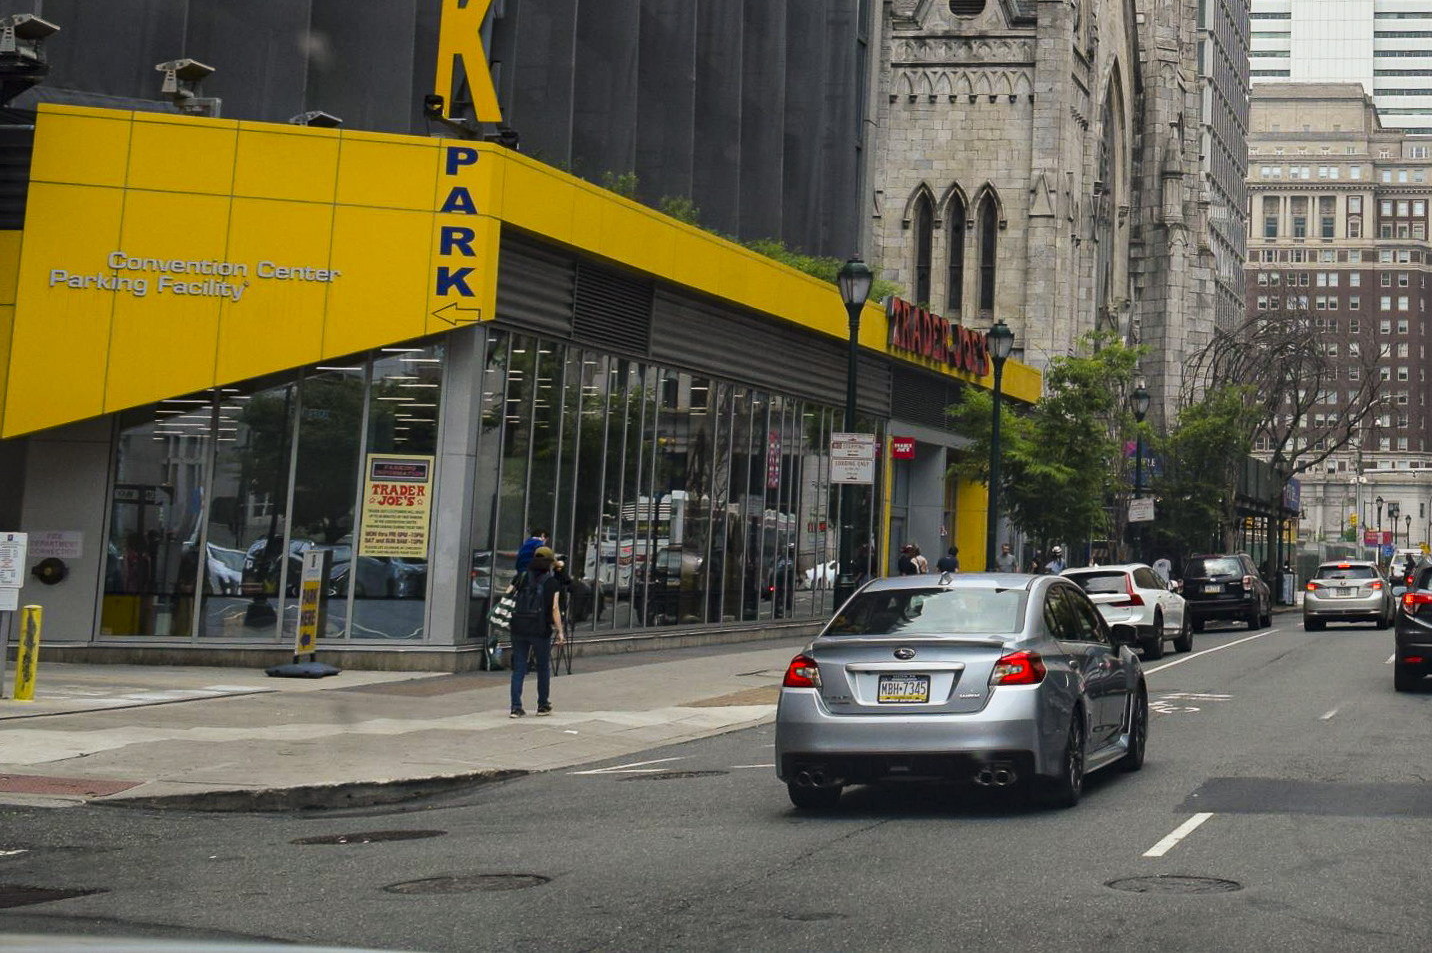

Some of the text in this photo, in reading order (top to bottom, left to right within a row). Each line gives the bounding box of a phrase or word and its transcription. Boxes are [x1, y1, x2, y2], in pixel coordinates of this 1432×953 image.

[436, 146, 479, 298] PARK
[107, 251, 341, 283] Convention Center
[50, 269, 148, 297] Parking
[892, 296, 949, 363] TRADER
[372, 484, 425, 497] TRADER
[377, 496, 415, 506] JOE'S
